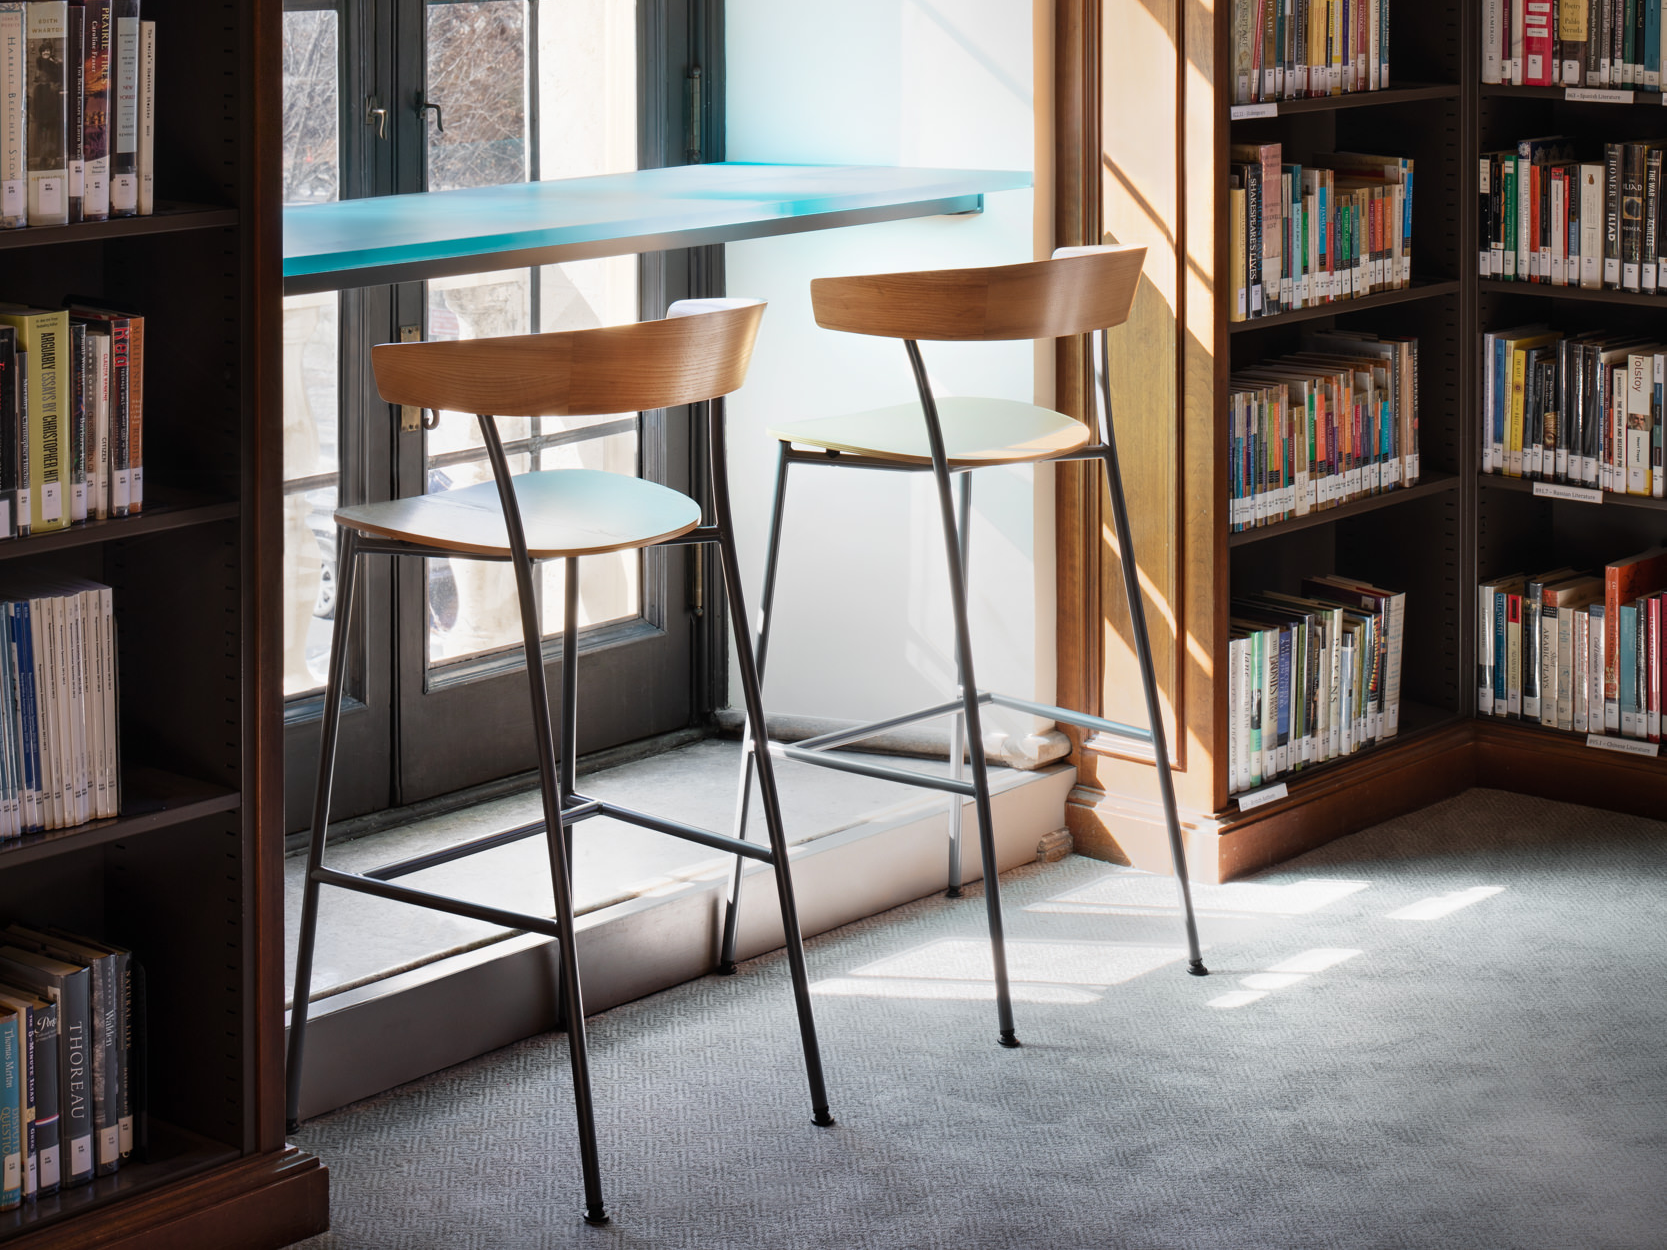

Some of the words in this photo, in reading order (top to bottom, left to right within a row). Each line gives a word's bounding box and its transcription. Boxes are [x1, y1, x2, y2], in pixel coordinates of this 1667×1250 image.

[101, 7, 110, 50] PRAIRIE
[101, 54, 109, 85] FIRES
[1609, 160, 1617, 197] HOMER
[1648, 170, 1656, 182] THE
[1648, 182, 1656, 197] WAR
[1646, 218, 1655, 247] ACHILLES
[40, 332, 56, 370] ARGUABLY
[114, 327, 129, 367] Red
[41, 372, 56, 401] ESSAYS
[1633, 356, 1644, 393] Tolstoy
[42, 402, 57, 413] BY
[42, 414, 58, 469] CHRISTOPHER
[4, 1028, 15, 1060] Thomas
[105, 1009, 114, 1047] Walden
[5, 1061, 15, 1088] Merton
[68, 1021, 85, 1120] THOREAU
